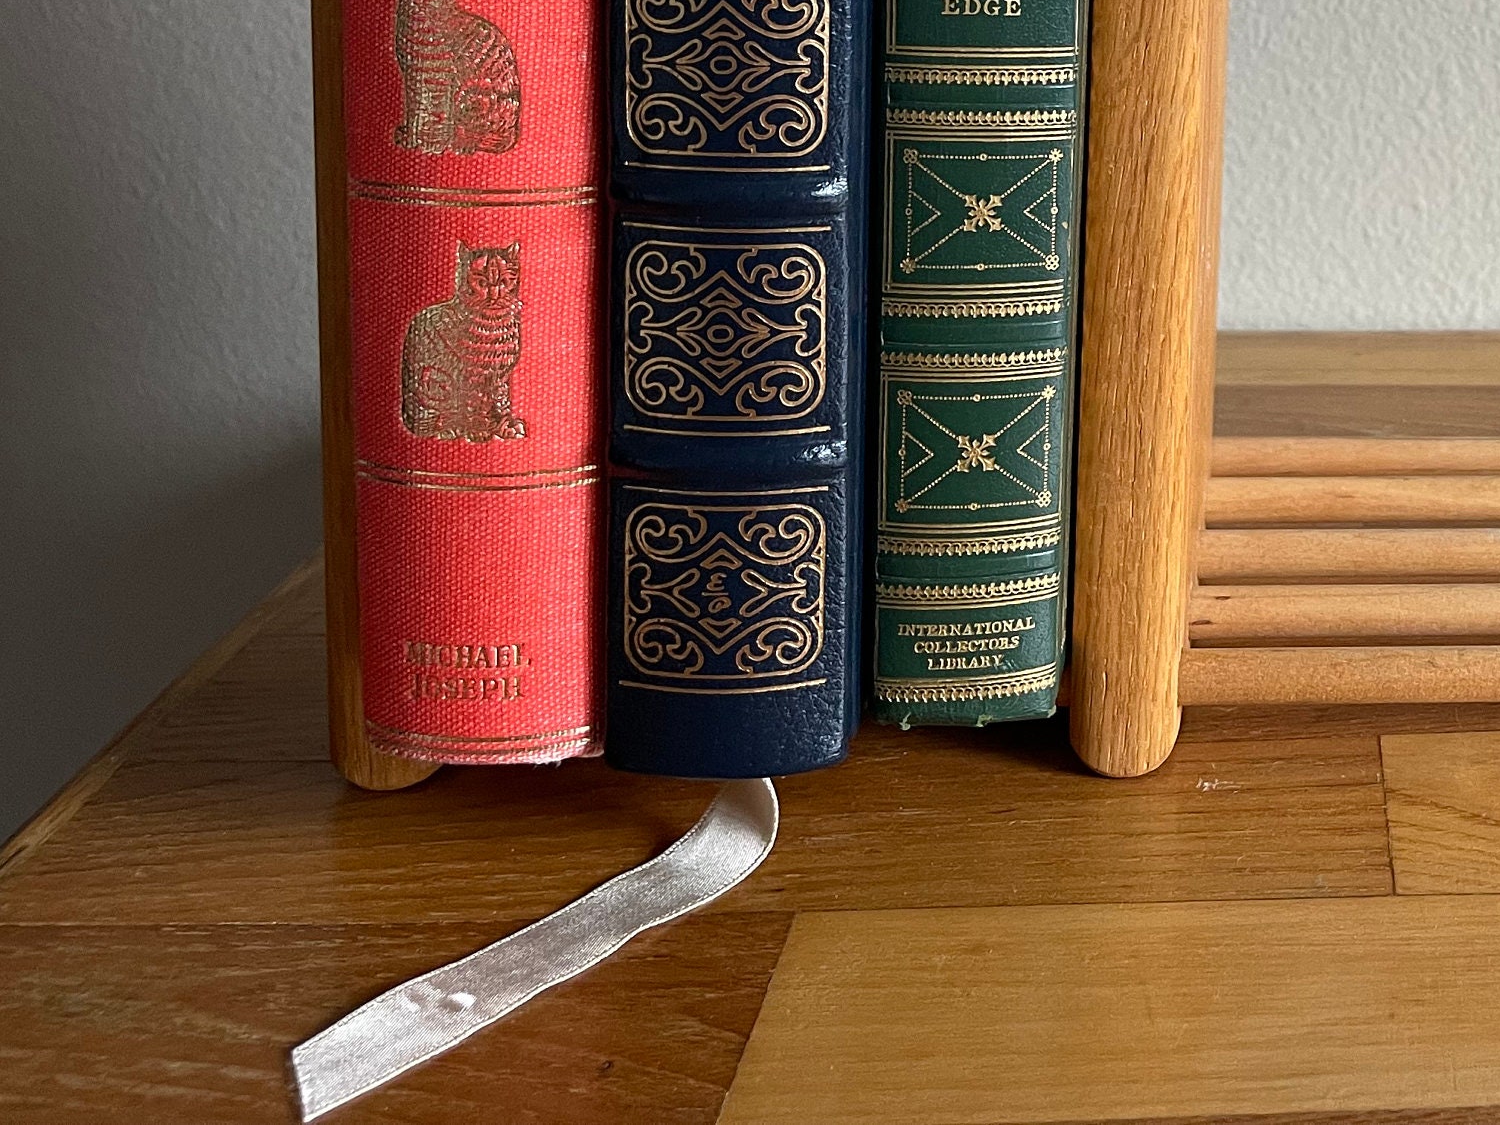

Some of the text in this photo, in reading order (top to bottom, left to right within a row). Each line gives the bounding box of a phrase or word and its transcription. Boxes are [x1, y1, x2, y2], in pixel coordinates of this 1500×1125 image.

[898, 616, 1036, 637] INTERNATIONAL
[402, 641, 532, 668] MICHAEL
[914, 635, 1020, 654] COLLECTORS
[927, 654, 1005, 671] LIBRARY
[411, 673, 525, 700] JOSEPH
